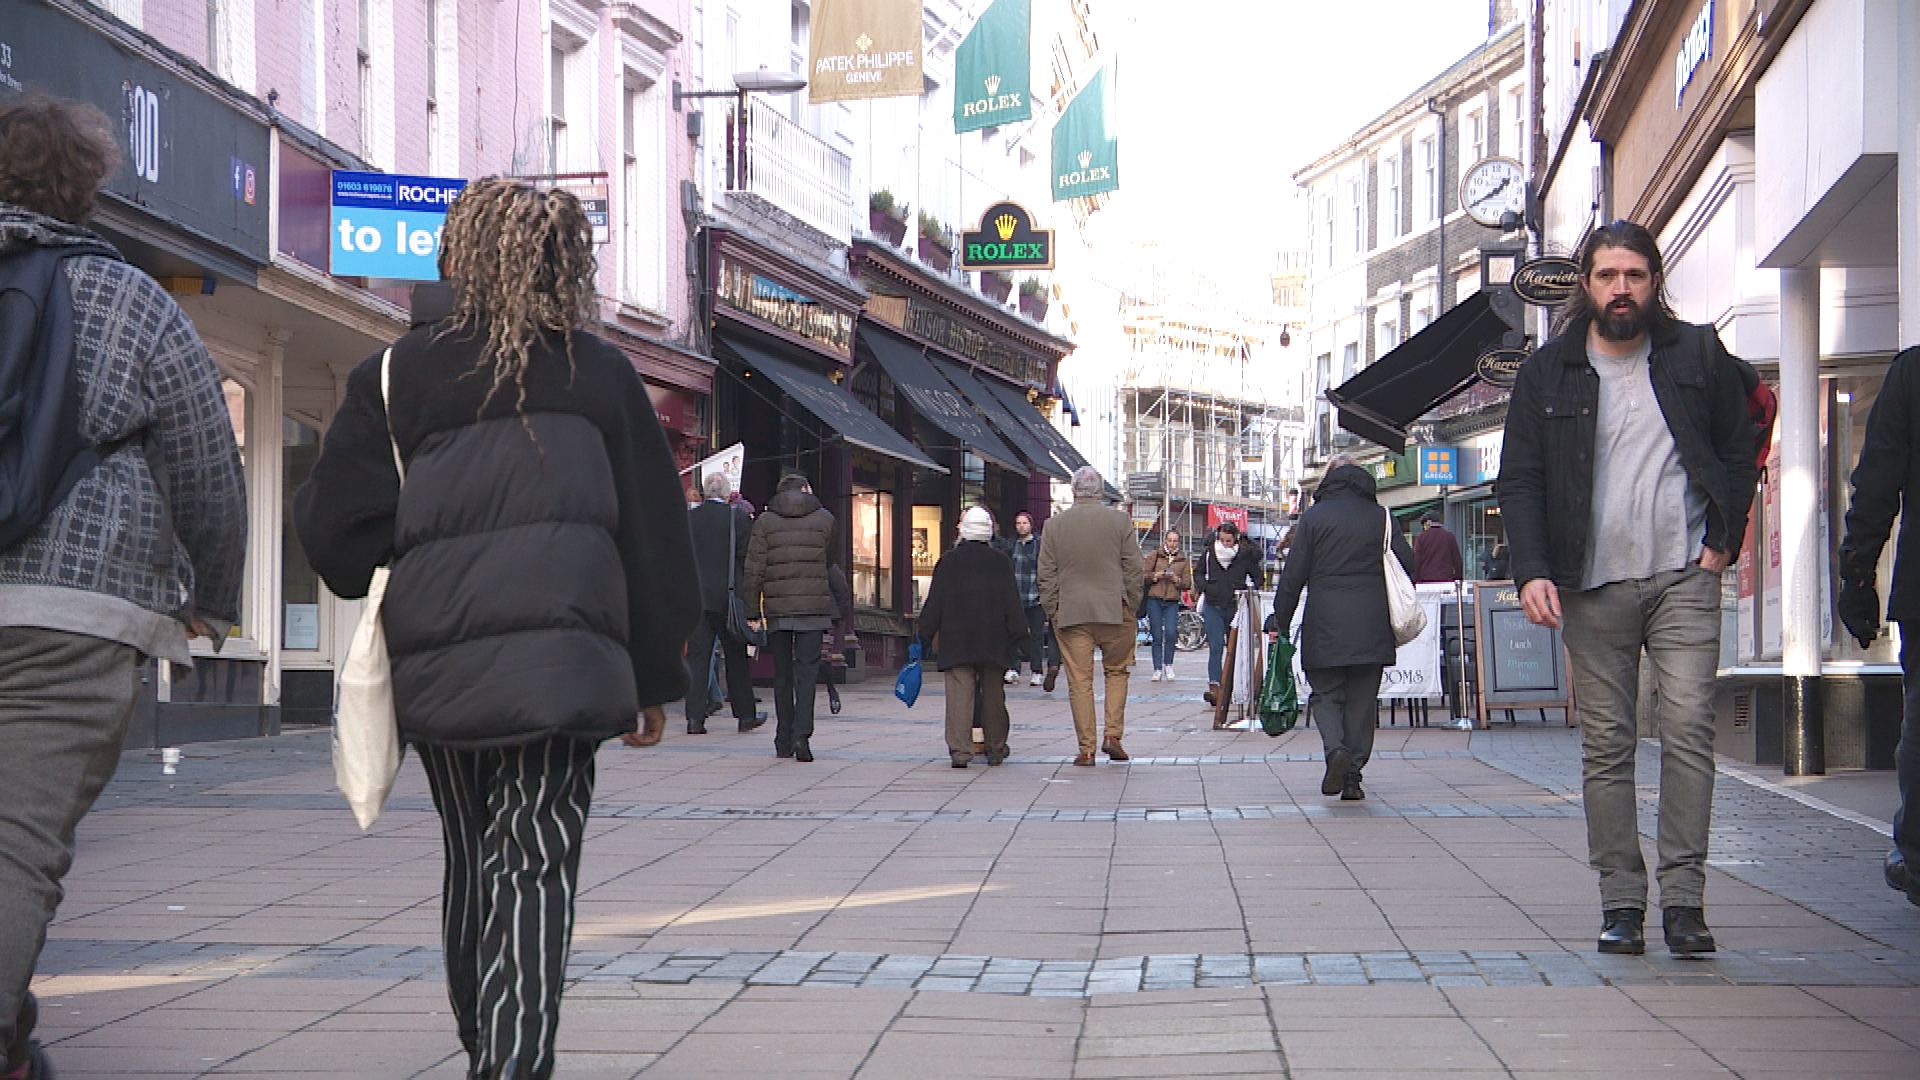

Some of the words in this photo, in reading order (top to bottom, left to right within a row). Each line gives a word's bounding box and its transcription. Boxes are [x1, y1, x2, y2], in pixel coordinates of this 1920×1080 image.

[816, 55, 855, 74] PATEK
[856, 50, 914, 70] PHILIPPE
[963, 92, 1022, 117] ROLEX
[1059, 165, 1111, 189] ROLEX
[338, 218, 382, 252] to
[396, 220, 445, 256] let
[967, 243, 1044, 261] ROLEX
[949, 320, 984, 360] BISHOP
[1424, 471, 1453, 479] GREGGS
